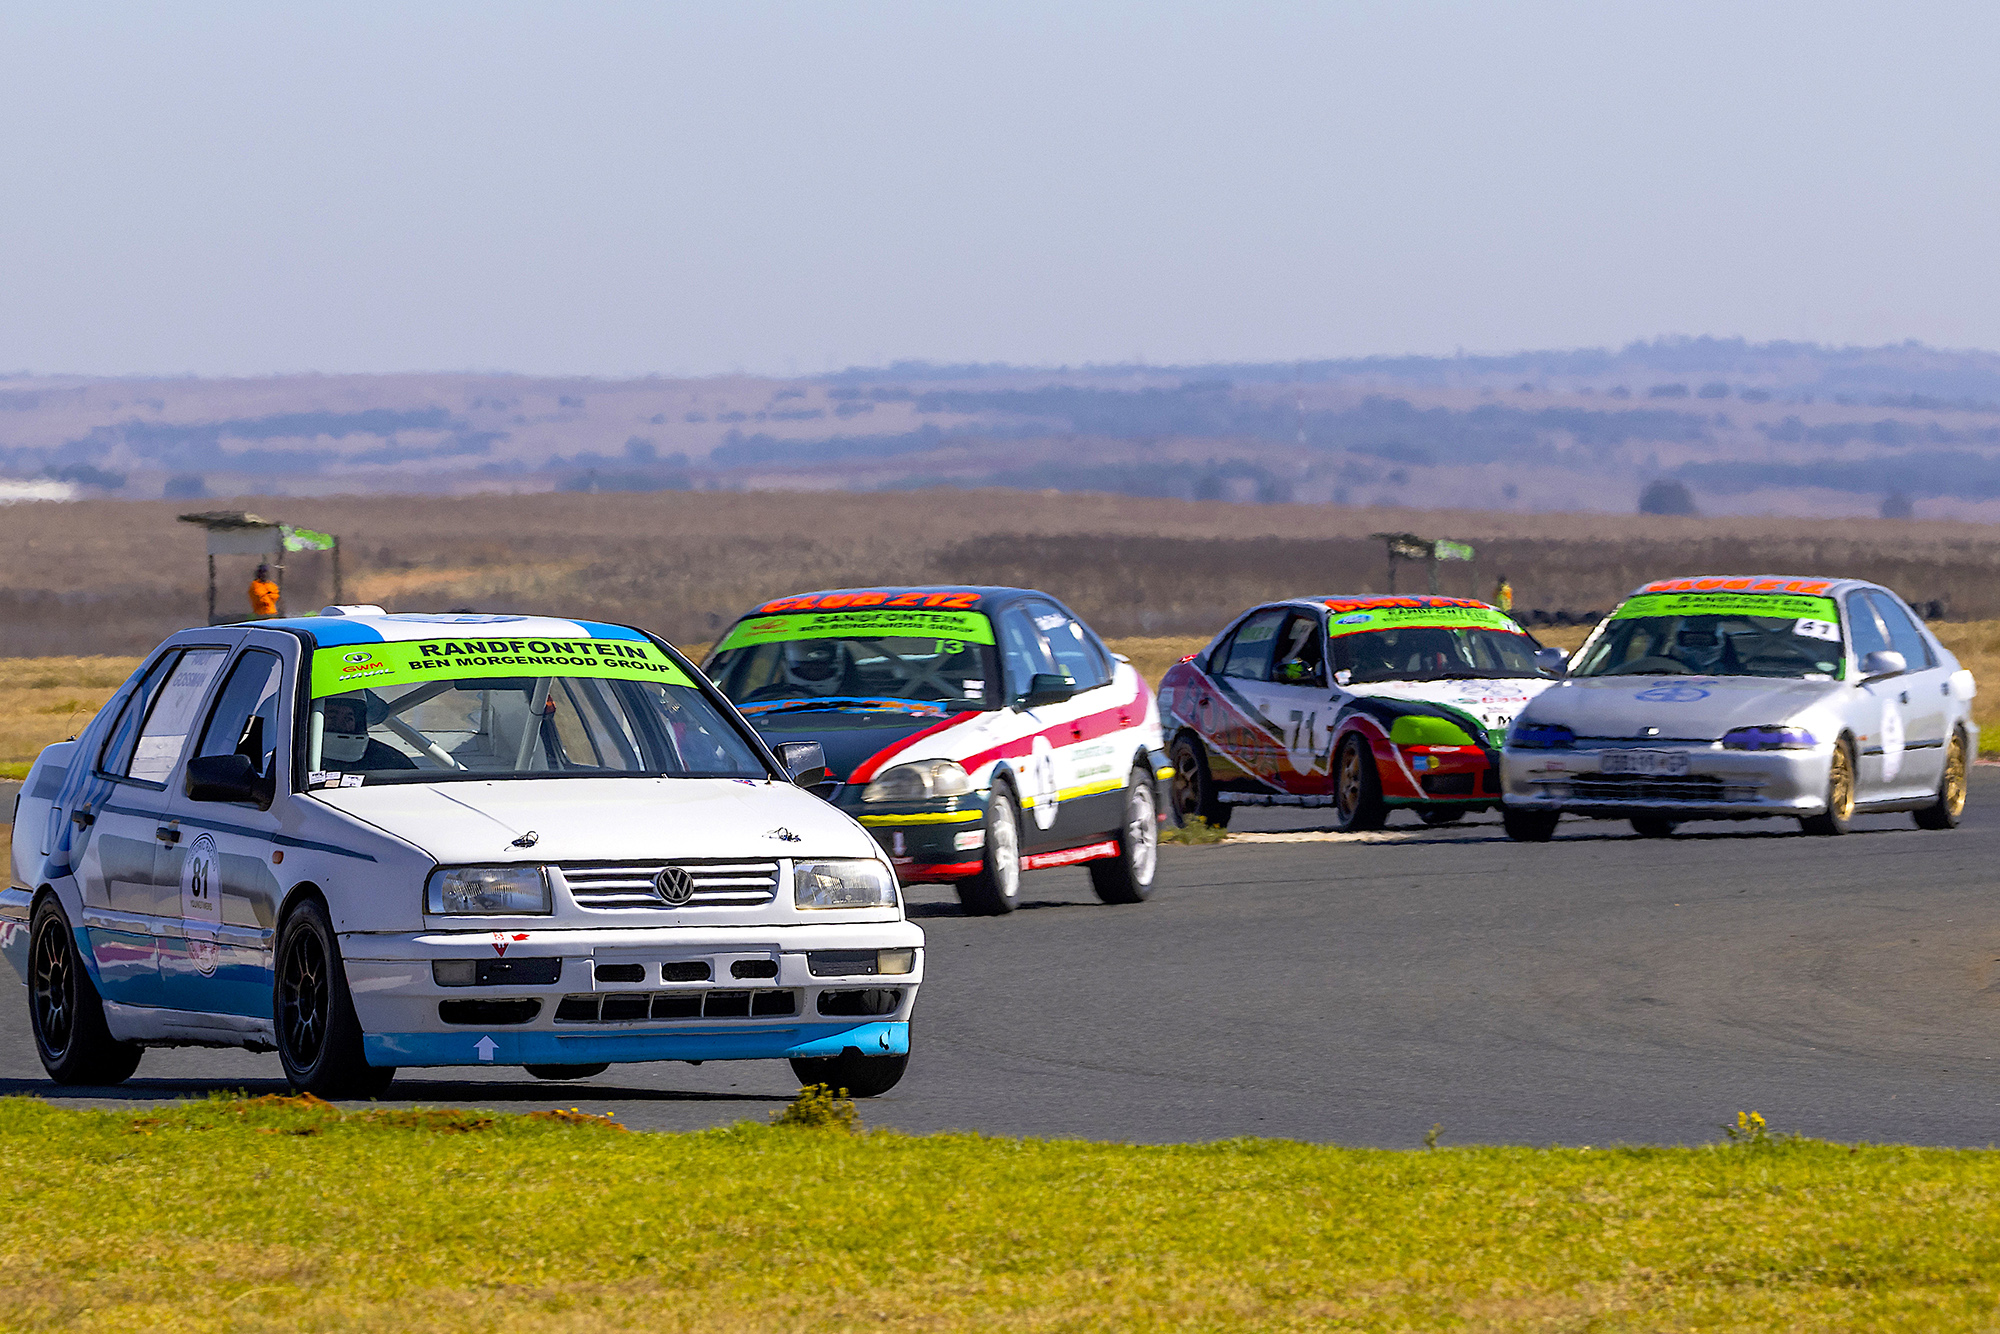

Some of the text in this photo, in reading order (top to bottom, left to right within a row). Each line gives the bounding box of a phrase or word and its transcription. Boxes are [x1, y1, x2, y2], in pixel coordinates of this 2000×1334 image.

[760, 592, 982, 613] CLUB 212
[418, 639, 648, 660] RANDFONTEIN
[935, 639, 965, 655] 13
[342, 661, 383, 673] GWM
[409, 655, 670, 674] BEN MORGENROOD GROUP
[338, 668, 395, 681] HAVAL
[191, 856, 209, 899] 81
